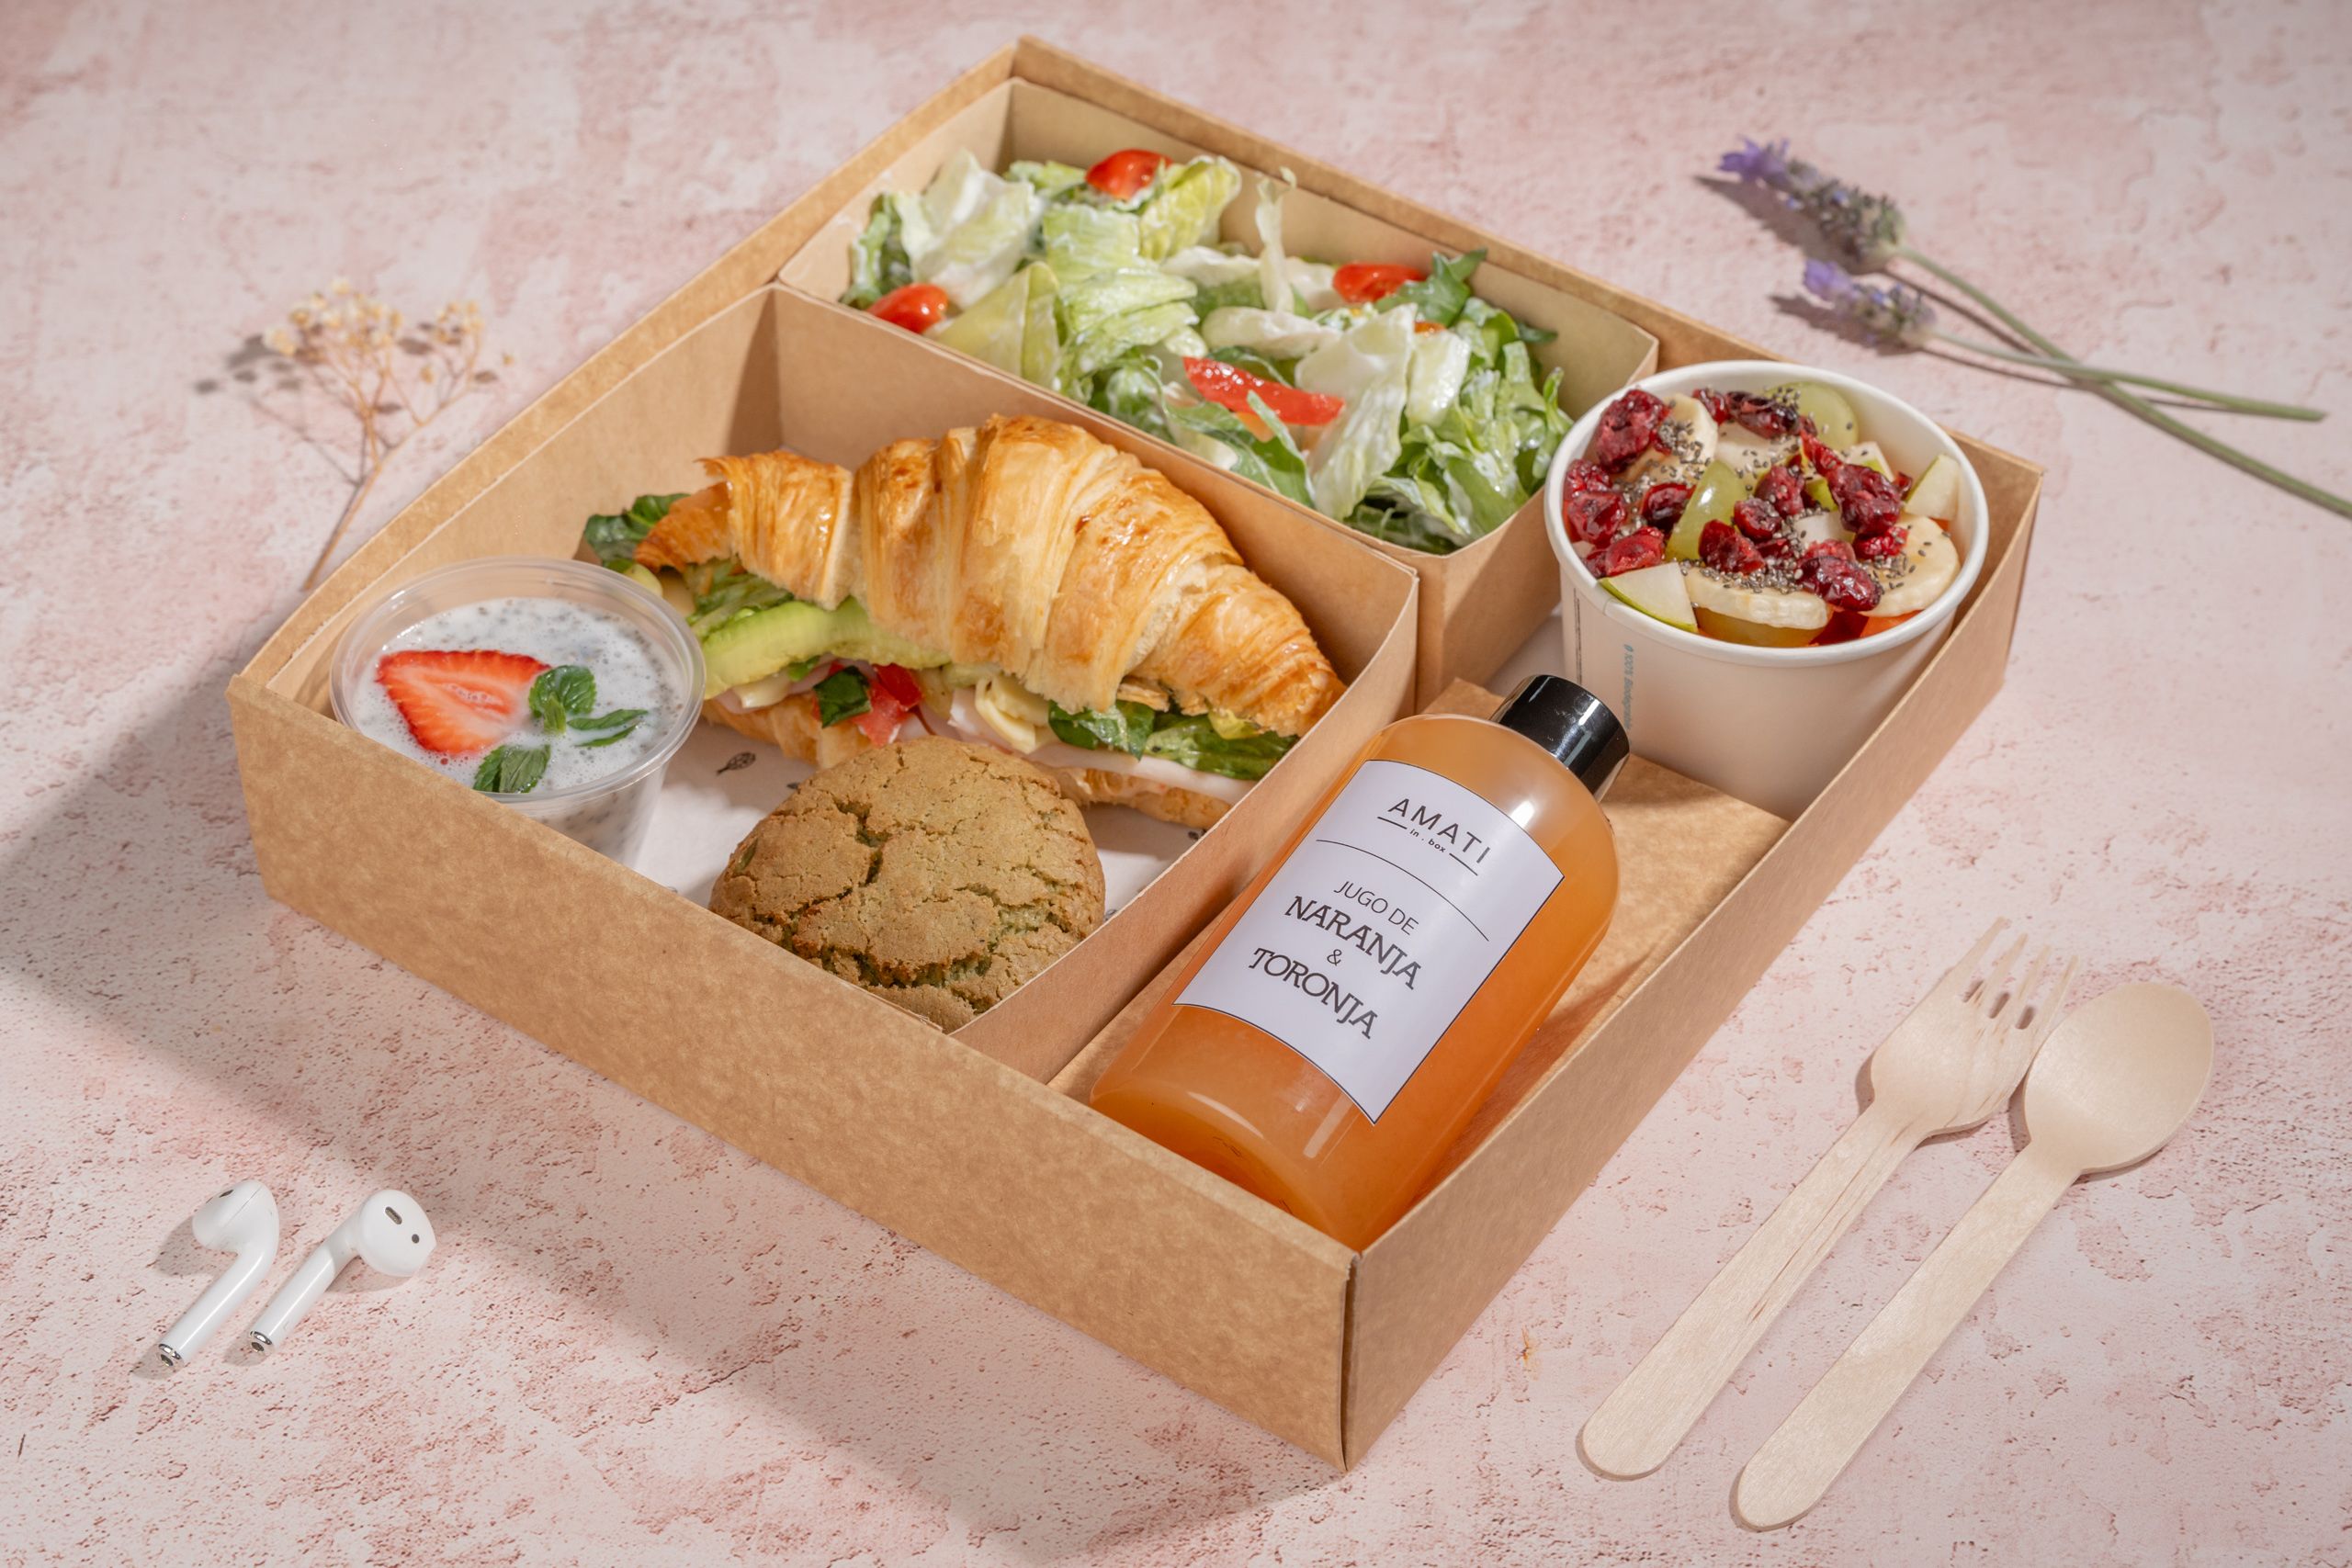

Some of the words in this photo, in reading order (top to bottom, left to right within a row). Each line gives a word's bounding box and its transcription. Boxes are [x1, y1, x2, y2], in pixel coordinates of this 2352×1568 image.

[1386, 797, 1491, 864] AMATI
[1409, 829, 1419, 838] in
[1428, 838, 1447, 853] box
[1333, 880, 1389, 914] JUGO
[1387, 907, 1419, 936] DE
[1283, 895, 1422, 991] NARANJA
[1326, 948, 1343, 967] &
[1248, 947, 1378, 1040] TORONJA
